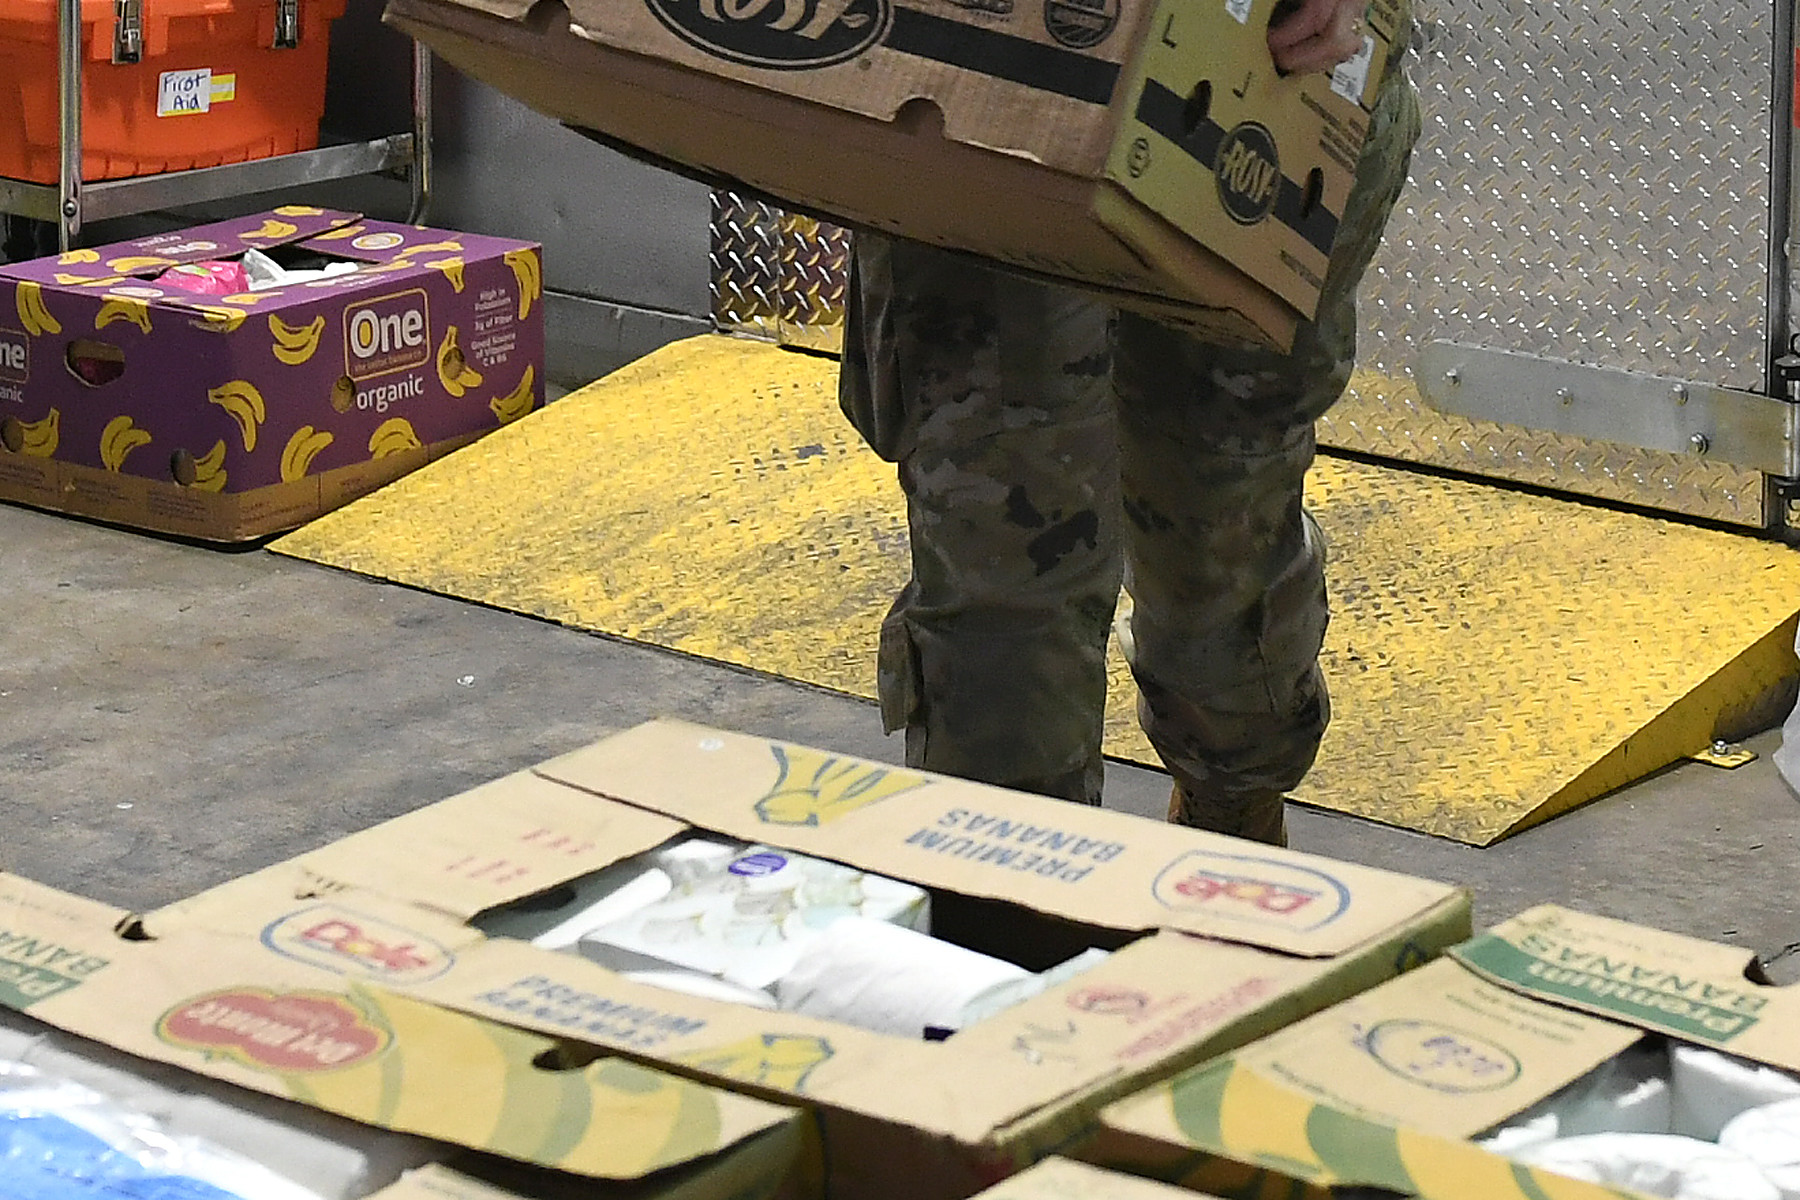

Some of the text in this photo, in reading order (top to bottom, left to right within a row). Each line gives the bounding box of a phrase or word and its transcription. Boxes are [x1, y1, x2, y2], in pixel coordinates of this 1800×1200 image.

[164, 72, 207, 92] First
[173, 93, 200, 110] Aid
[350, 309, 424, 359] One
[356, 373, 425, 413] organic
[904, 827, 1094, 883] PREMIUM
[938, 808, 1126, 863] BANANAS
[1521, 934, 1770, 1012] BANANAS
[1527, 960, 1746, 1033] Premium
